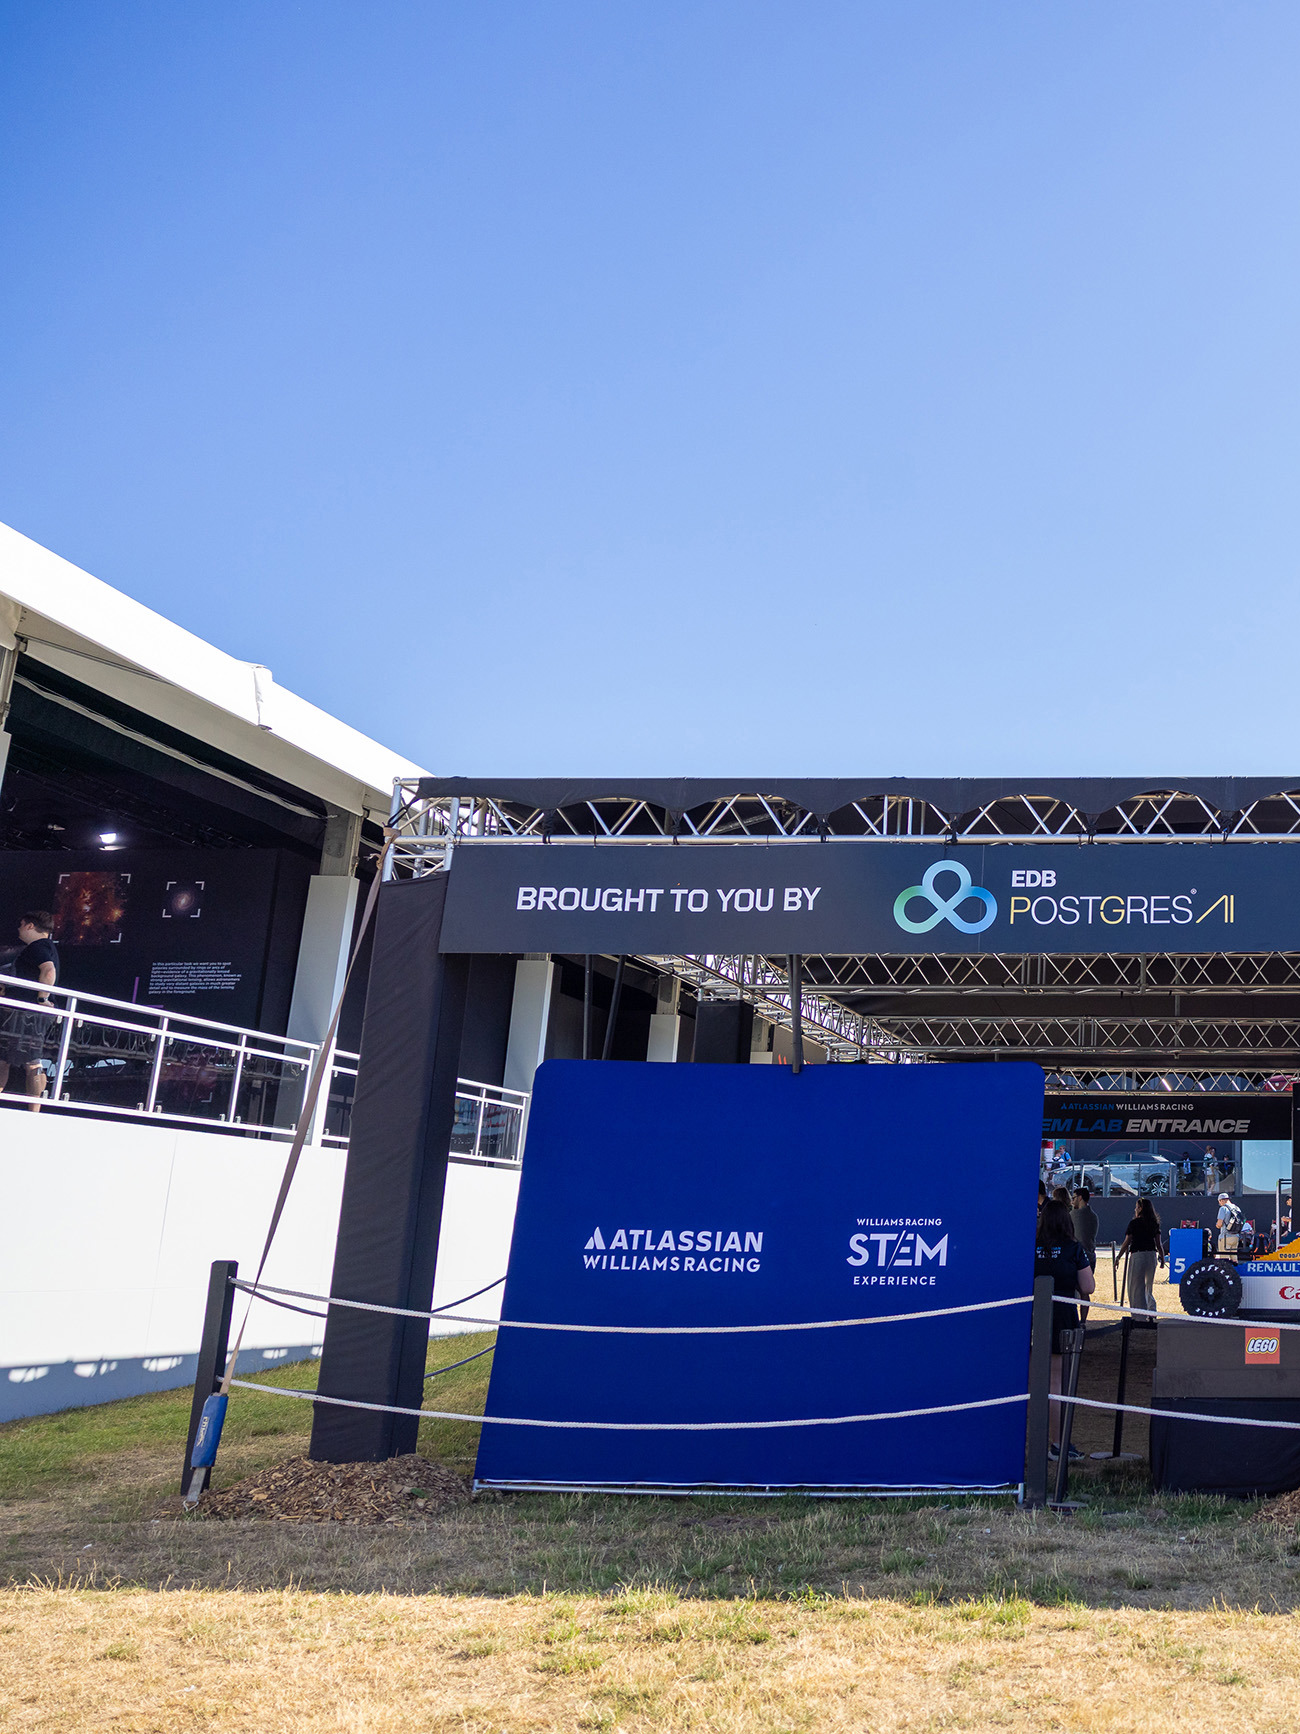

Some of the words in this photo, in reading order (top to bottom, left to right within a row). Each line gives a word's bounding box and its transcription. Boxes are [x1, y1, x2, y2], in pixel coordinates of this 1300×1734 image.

[1010, 870, 1057, 888] EDB
[516, 887, 664, 912] BROUGHT
[670, 889, 708, 912] TO
[717, 888, 774, 912] YOU
[783, 887, 821, 911] BY
[1069, 1103, 1114, 1111] ATLASSIAN
[1075, 1119, 1122, 1132] LAB
[1126, 1119, 1251, 1133] ENTRANCE
[610, 1229, 763, 1252] ATLASSIAN
[846, 1230, 948, 1269] STEM
[1174, 1258, 1185, 1273] 5
[854, 1276, 935, 1286] EXPERIENCE
[1247, 1338, 1278, 1353] LEGO
